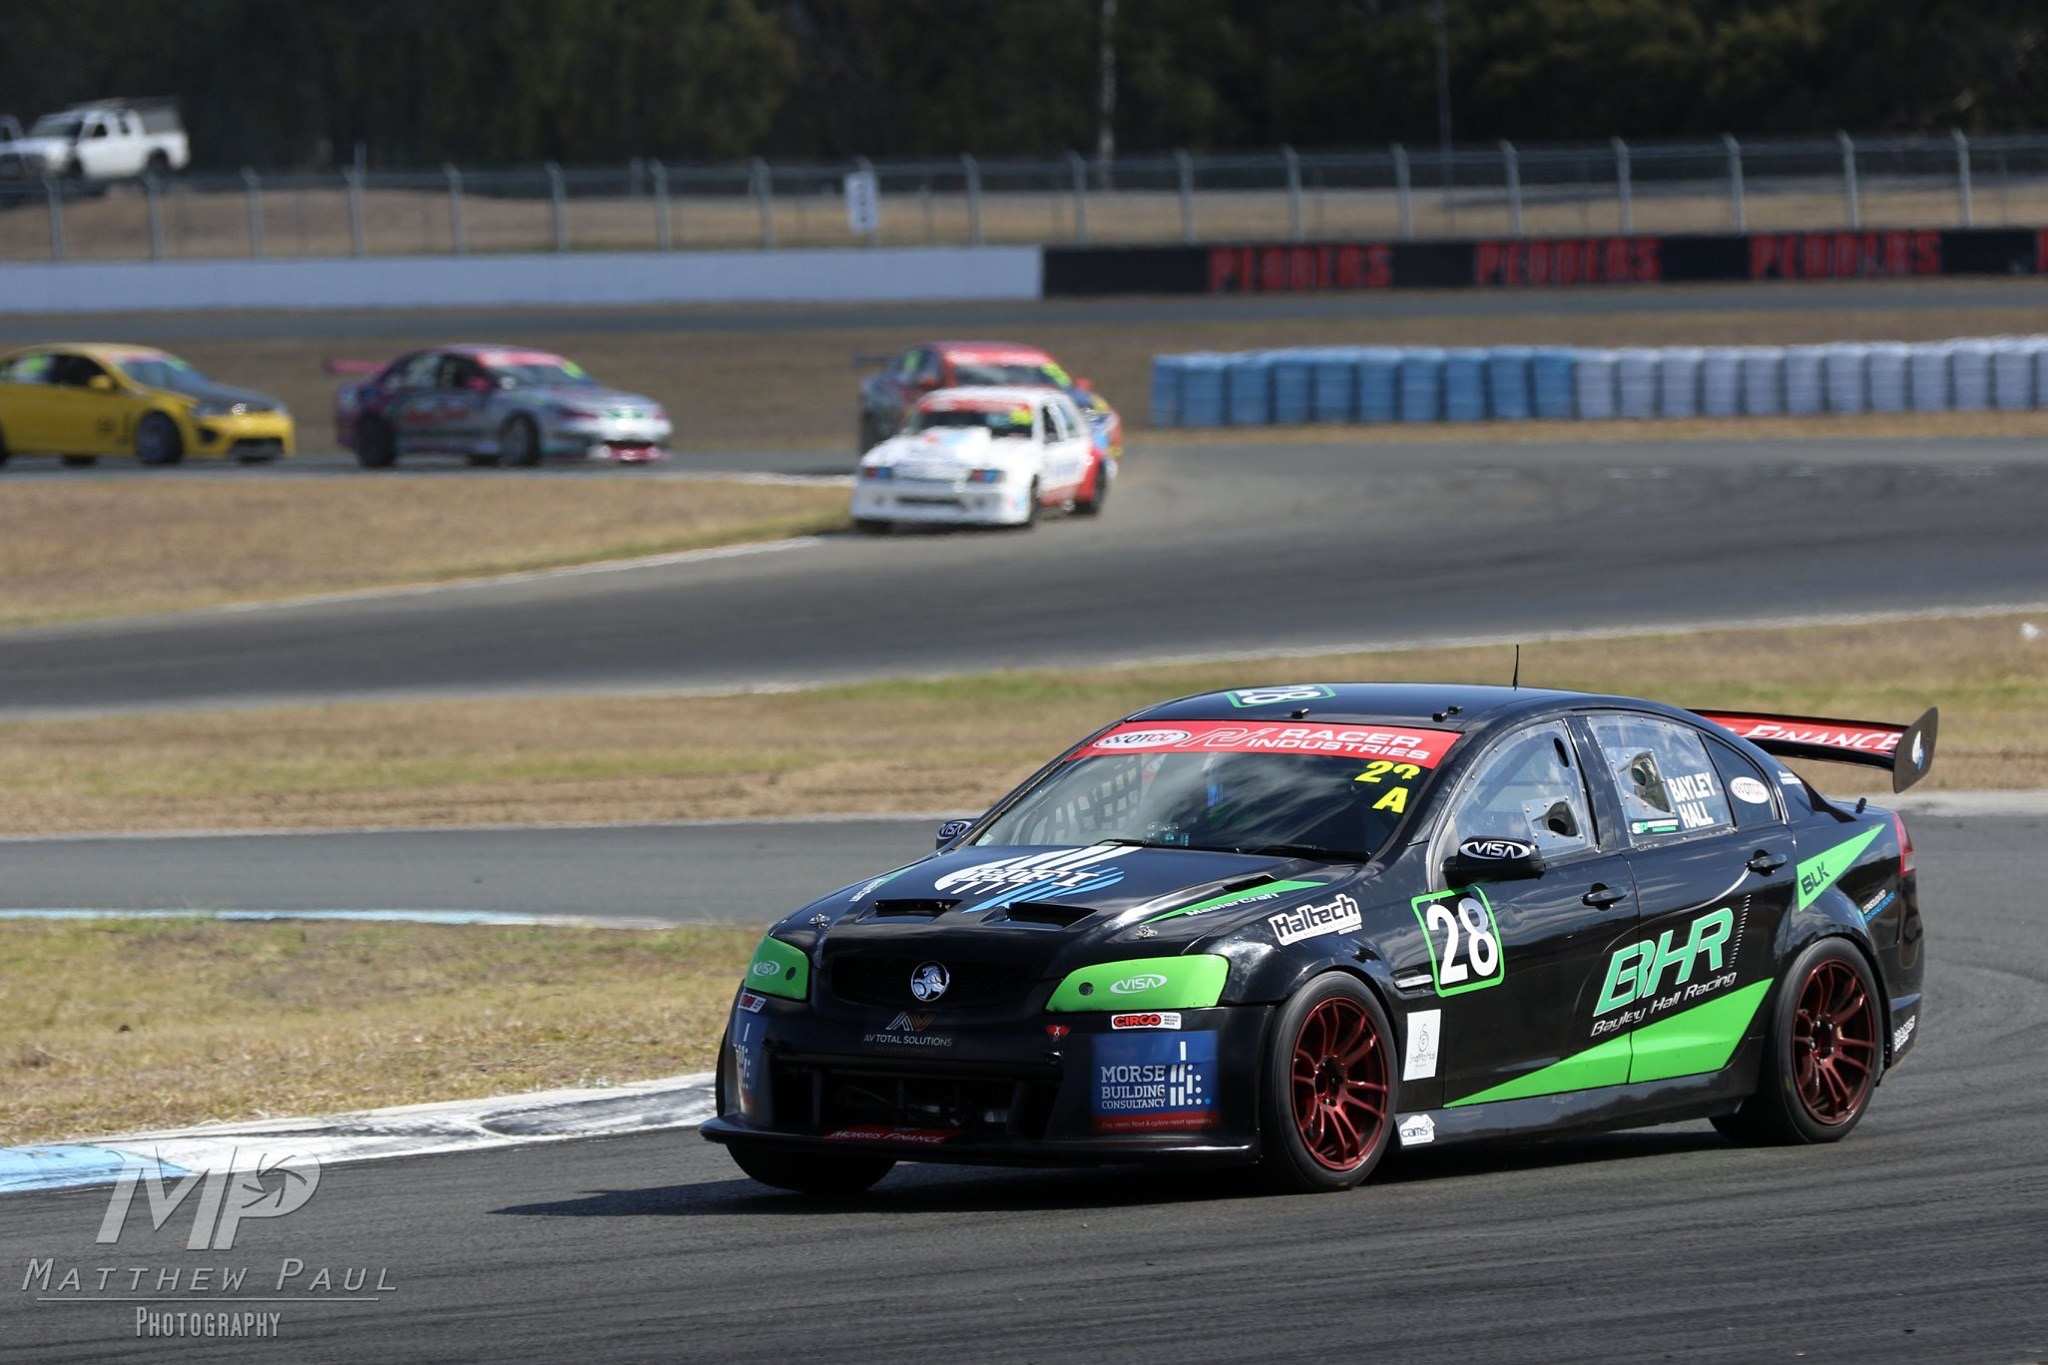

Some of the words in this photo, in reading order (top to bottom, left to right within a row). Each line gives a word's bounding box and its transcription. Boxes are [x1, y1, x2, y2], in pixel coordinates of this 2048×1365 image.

[1247, 738, 1431, 760] INDUSTRIES
[1279, 728, 1424, 748] RACER
[1667, 772, 1716, 802] BAYLEY
[1372, 786, 1409, 813] A
[1677, 801, 1715, 829] HALL
[1474, 841, 1516, 860] VISA
[1801, 861, 1830, 895] BLK
[1273, 897, 1357, 938] Haltech
[1426, 897, 1499, 985] 28
[1592, 906, 1734, 1017] BHR
[1118, 977, 1160, 991] VISA
[1590, 1008, 1647, 1037] Bayley
[1651, 991, 1681, 1014] Hall
[1684, 972, 1738, 1000] Racing
[1115, 1015, 1161, 1027] CIRCO
[876, 1034, 902, 1044] TOTAL
[903, 1036, 952, 1047] SOLUTIONS
[1101, 1065, 1166, 1084] MORSE
[1102, 1085, 1165, 1099] BUILDING
[1102, 1099, 1166, 1109] CONSULTANCY
